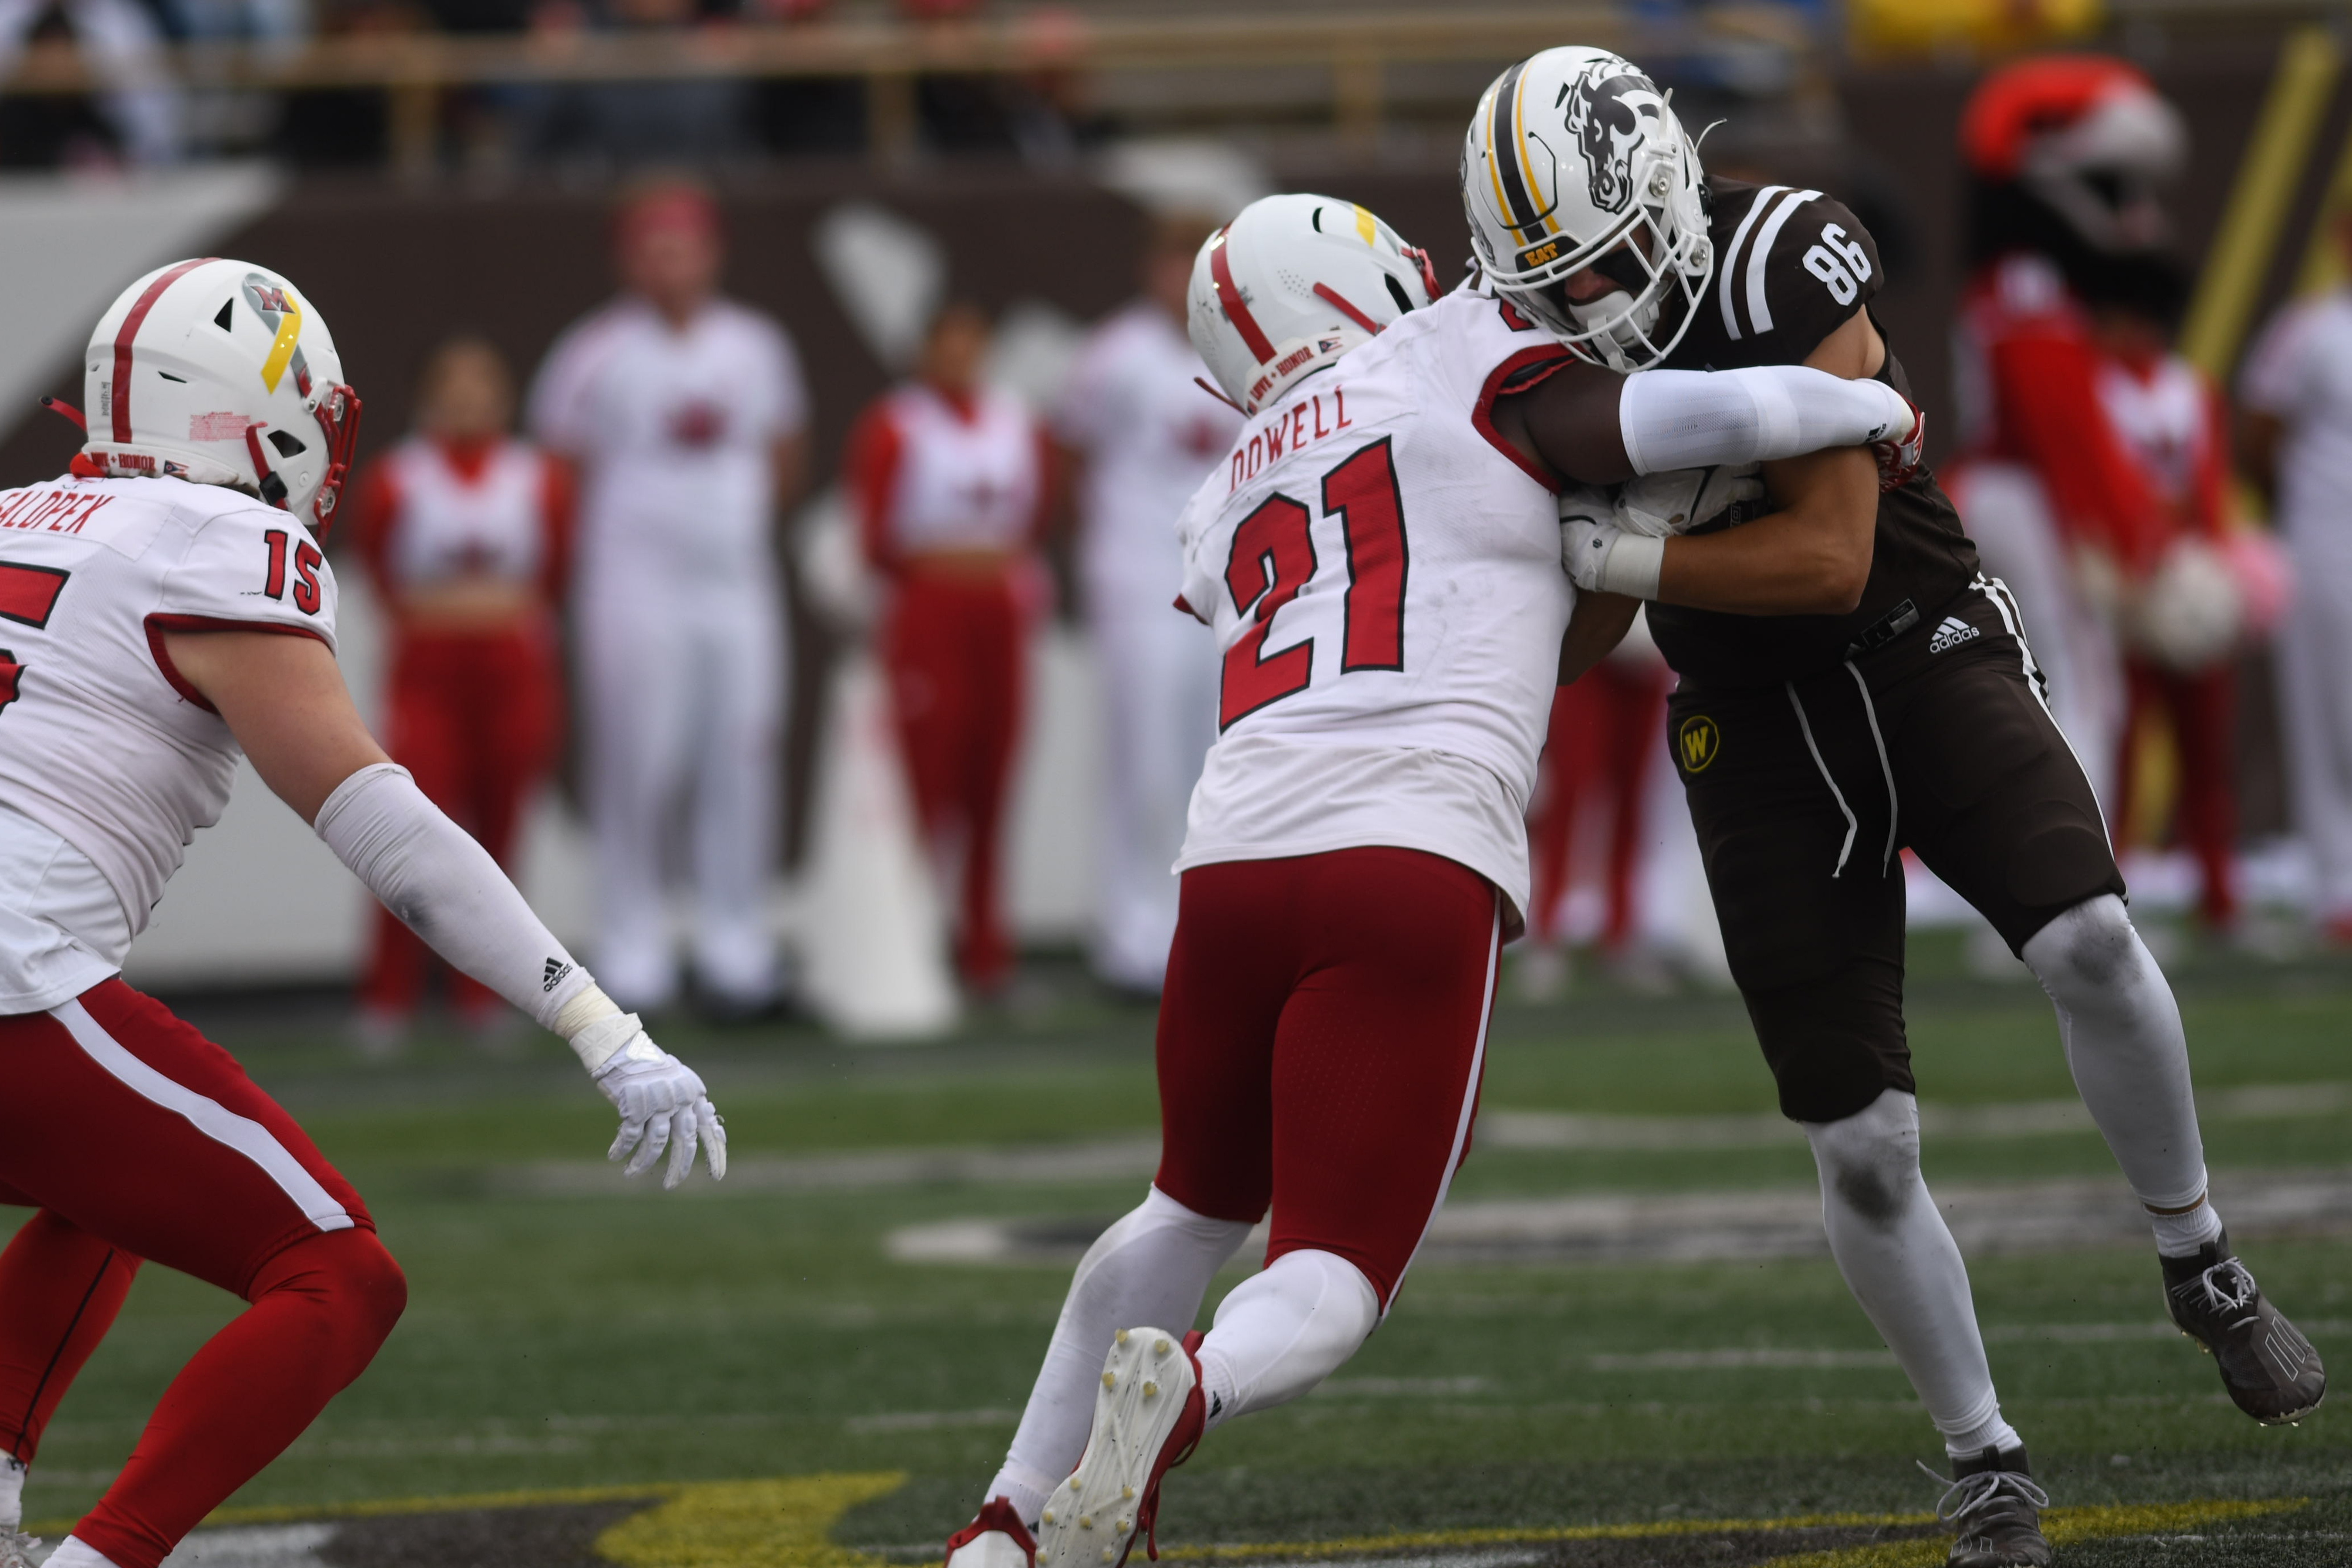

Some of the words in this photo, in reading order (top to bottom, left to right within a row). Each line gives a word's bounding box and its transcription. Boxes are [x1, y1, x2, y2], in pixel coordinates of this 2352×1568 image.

[1525, 242, 1558, 267] EAT
[1802, 223, 1872, 306] 86
[250, 286, 296, 314] M
[1250, 375, 1273, 401] LOVE
[1276, 346, 1314, 377] HONOR
[1229, 385, 1352, 494] DOWELL
[118, 453, 156, 471] HONOR
[264, 529, 323, 616] 15
[1219, 434, 1409, 736] 21
[1930, 627, 1980, 654] adidas
[1685, 726, 1709, 764] W
[544, 963, 573, 992] adidas
